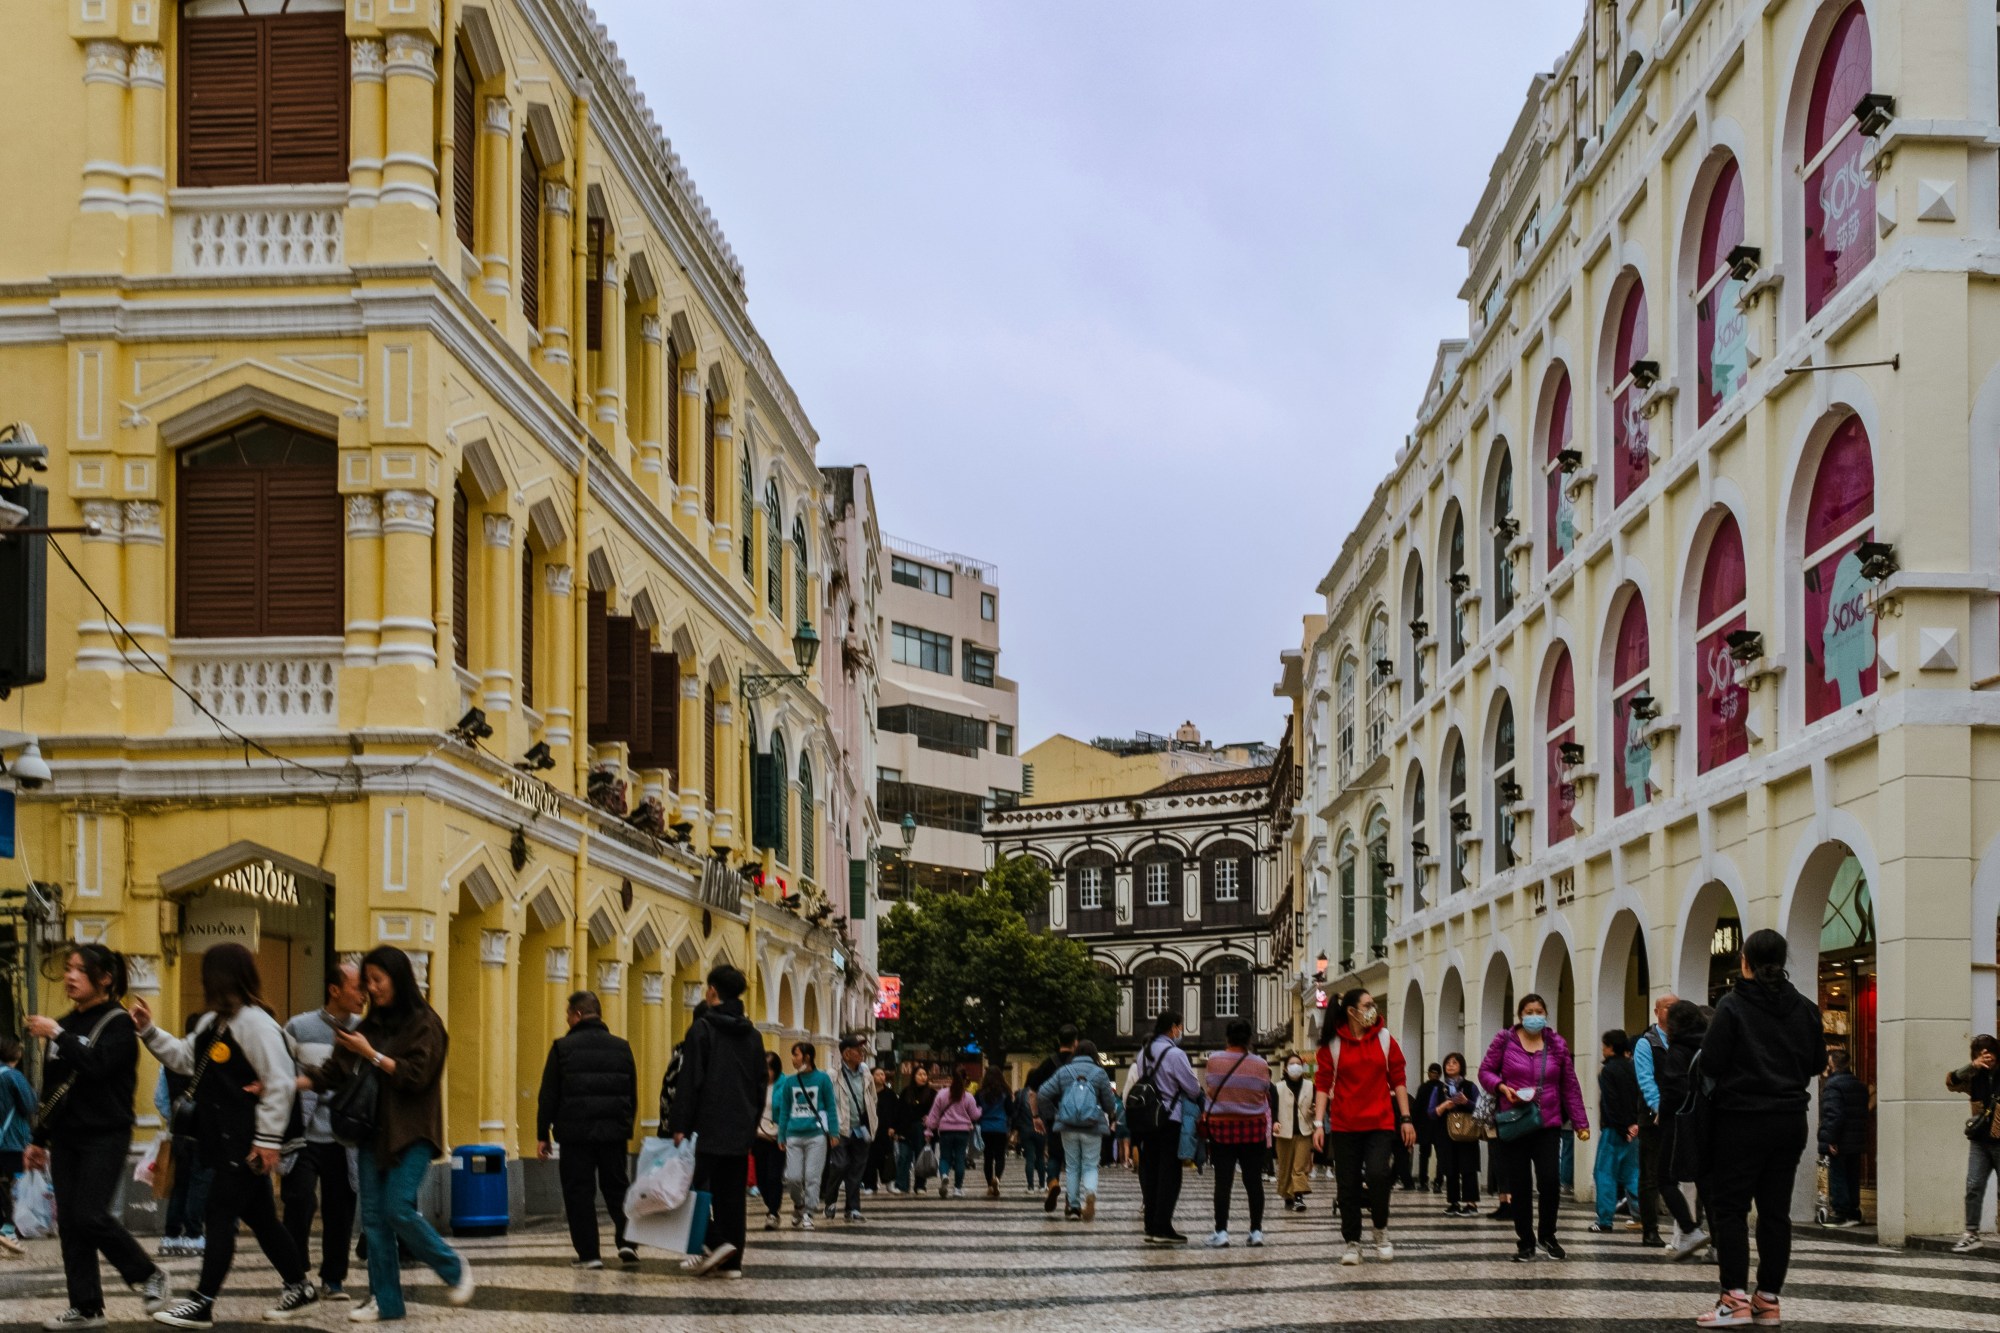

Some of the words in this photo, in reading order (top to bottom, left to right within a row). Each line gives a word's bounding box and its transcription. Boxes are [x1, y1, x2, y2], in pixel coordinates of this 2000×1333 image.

[512, 775, 560, 820] PANDORA
[213, 860, 299, 906] ANDORA
[184, 921, 247, 936] ANDORA
